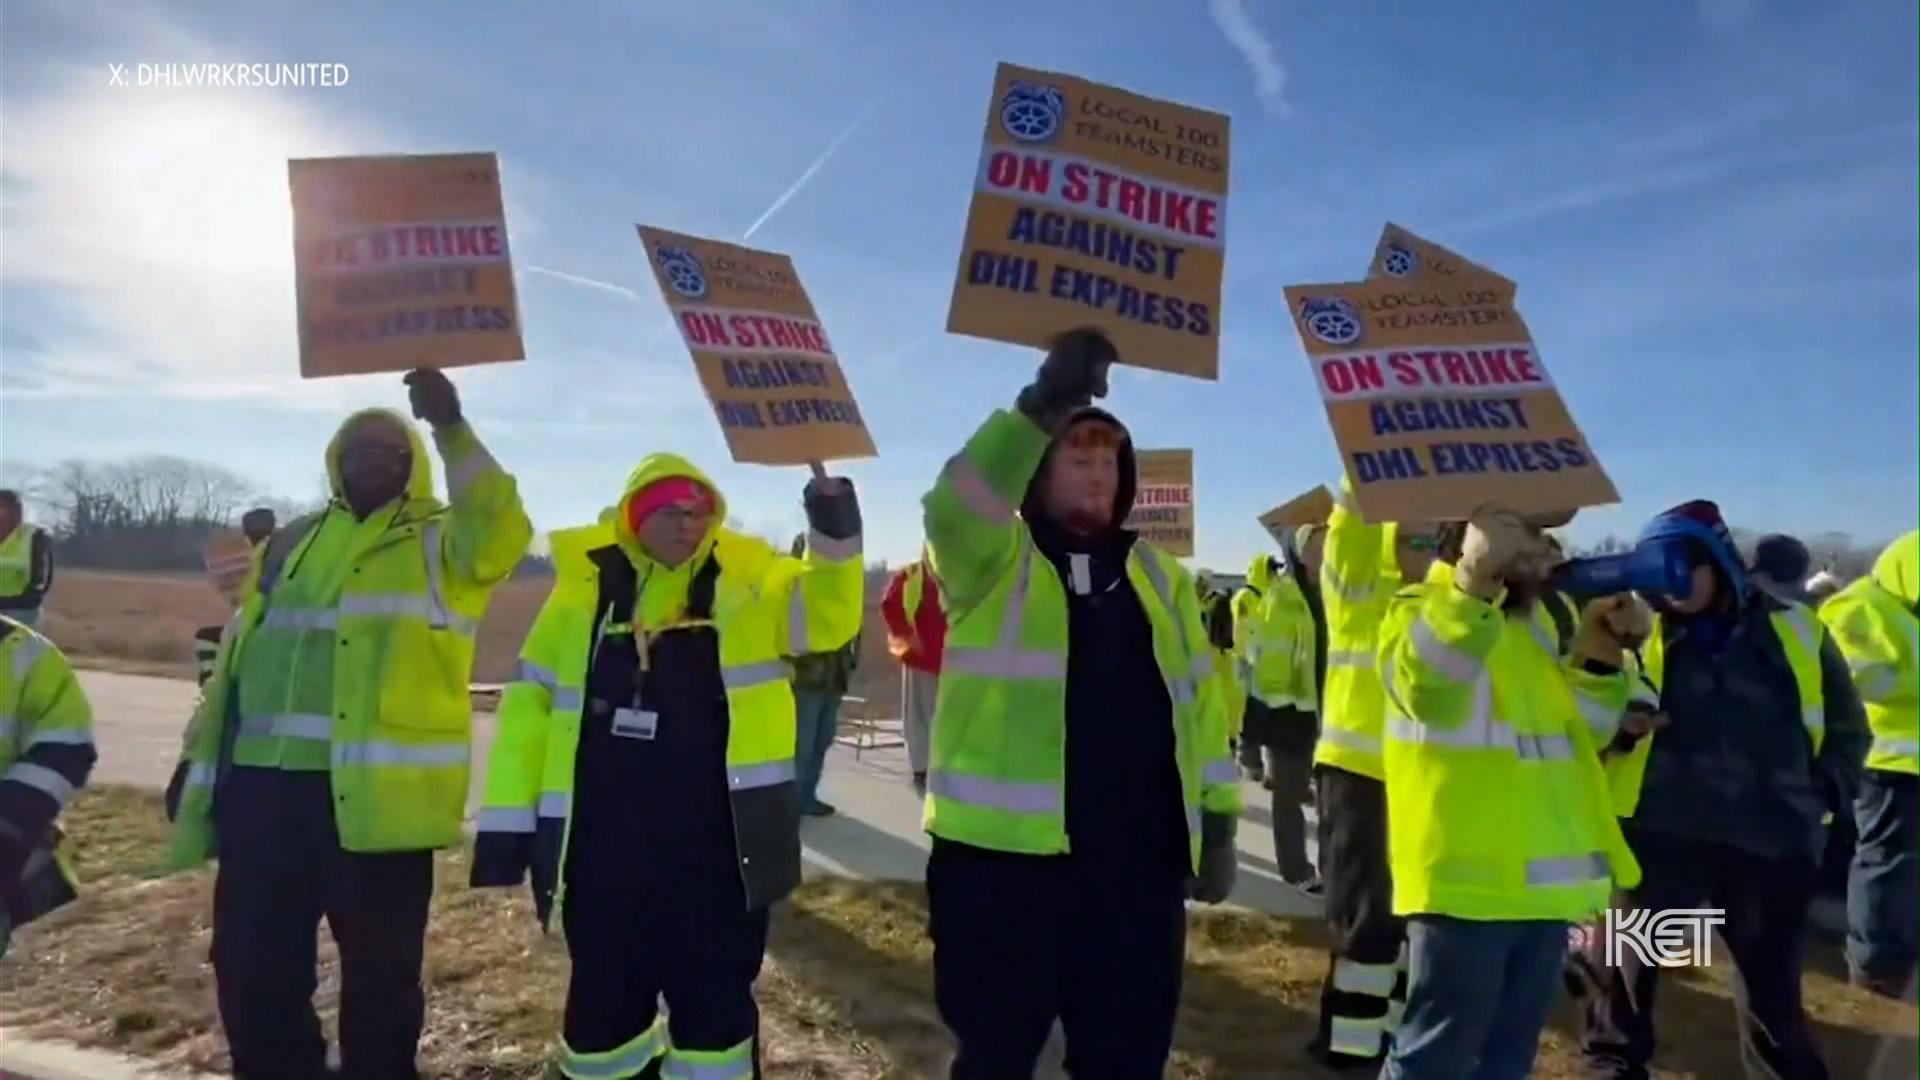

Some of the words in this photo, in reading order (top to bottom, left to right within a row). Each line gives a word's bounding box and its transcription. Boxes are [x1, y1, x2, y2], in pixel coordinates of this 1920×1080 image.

[1079, 97, 1166, 134] LOCAL
[1175, 124, 1219, 148] 100
[1075, 122, 1223, 172] TEAMSTERS
[988, 152, 1053, 194] ON
[1061, 163, 1217, 239] STRIKE
[1007, 207, 1184, 280] AGAINST
[968, 251, 1039, 293] DHL
[1050, 265, 1211, 336] EXPRESS
[1368, 293, 1447, 310] LOCAL
[681, 312, 729, 345] ON
[729, 315, 831, 355] STRIKE
[721, 359, 830, 389] AGAINST
[1321, 355, 1384, 394] ON
[1388, 350, 1542, 386] STRIKE
[1370, 398, 1528, 436] AGAINST
[1351, 447, 1427, 484] DHL
[1428, 438, 1589, 477] EXPRESS
